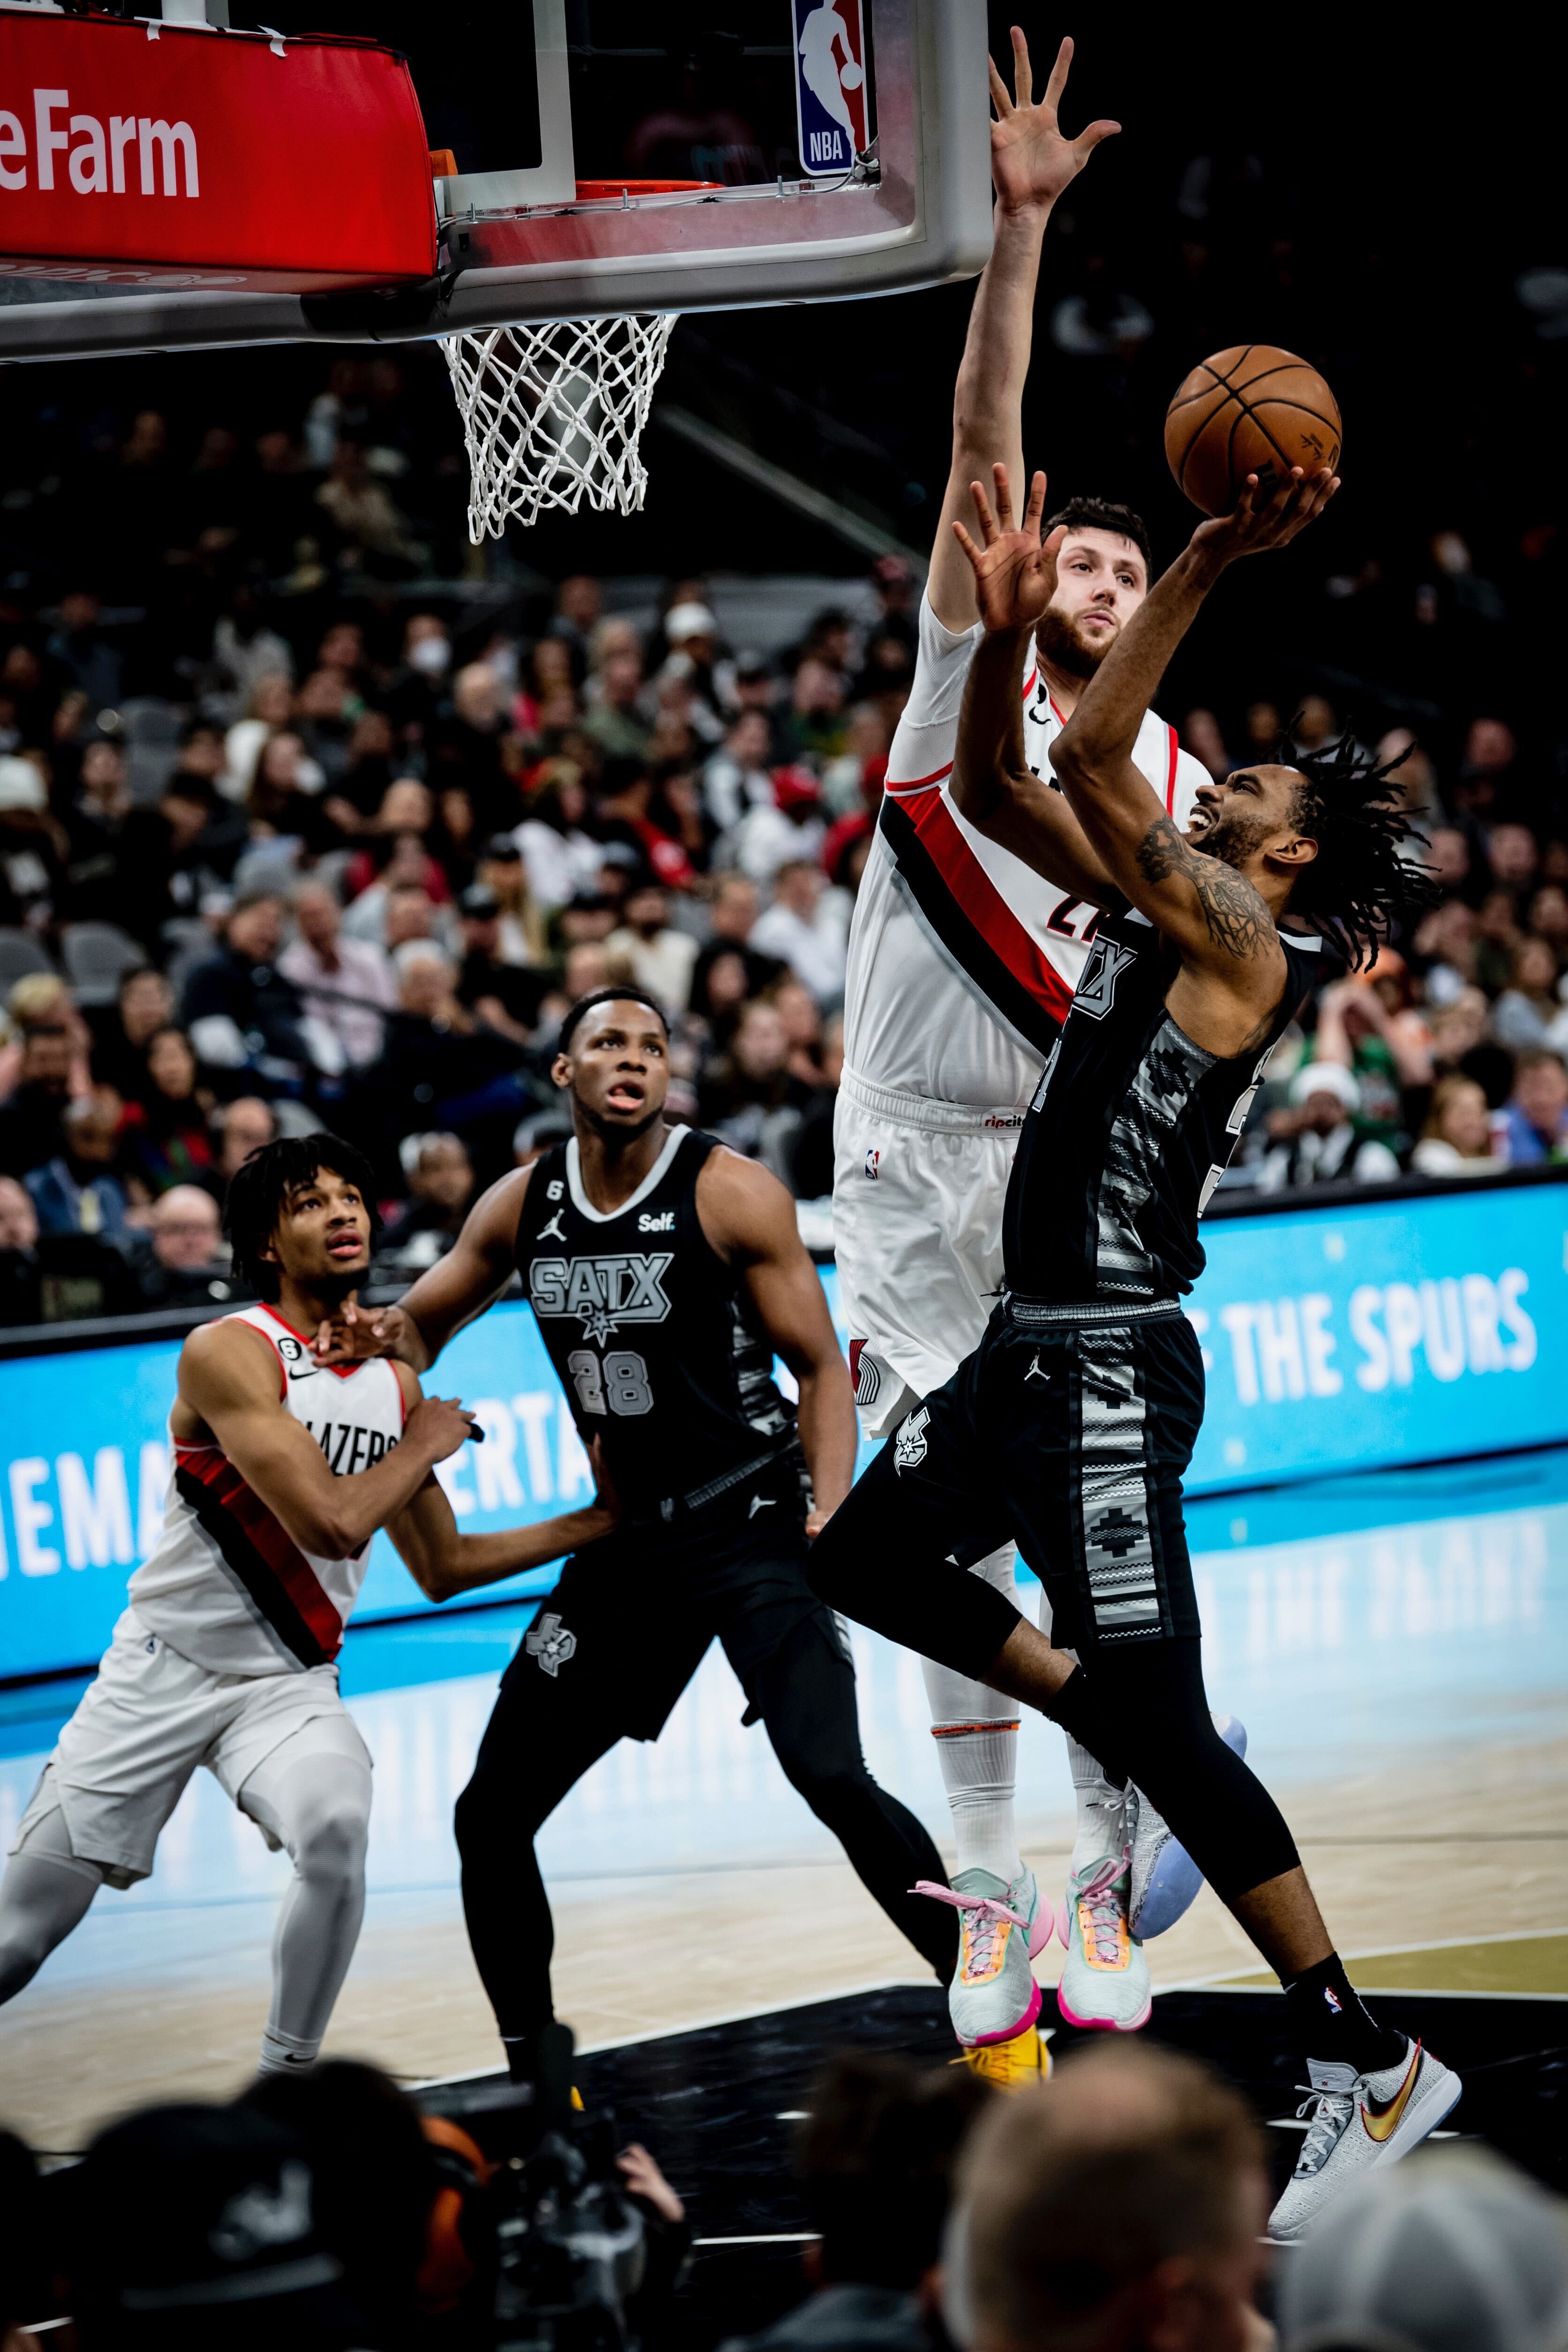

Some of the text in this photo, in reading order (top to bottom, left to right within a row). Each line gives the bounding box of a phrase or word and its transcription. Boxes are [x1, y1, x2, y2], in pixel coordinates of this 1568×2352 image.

[0, 89, 199, 197] eFarm
[810, 130, 843, 161] NBA
[985, 1115, 1025, 1129] ripcit
[546, 1180, 565, 1201] 6
[529, 1253, 674, 1323] SATX
[280, 1340, 298, 1360] 6
[1220, 1293, 1344, 1405] THE
[1349, 1267, 1538, 1392] SPURS
[567, 1349, 654, 1416] 28
[0, 1440, 170, 1582] EMA
